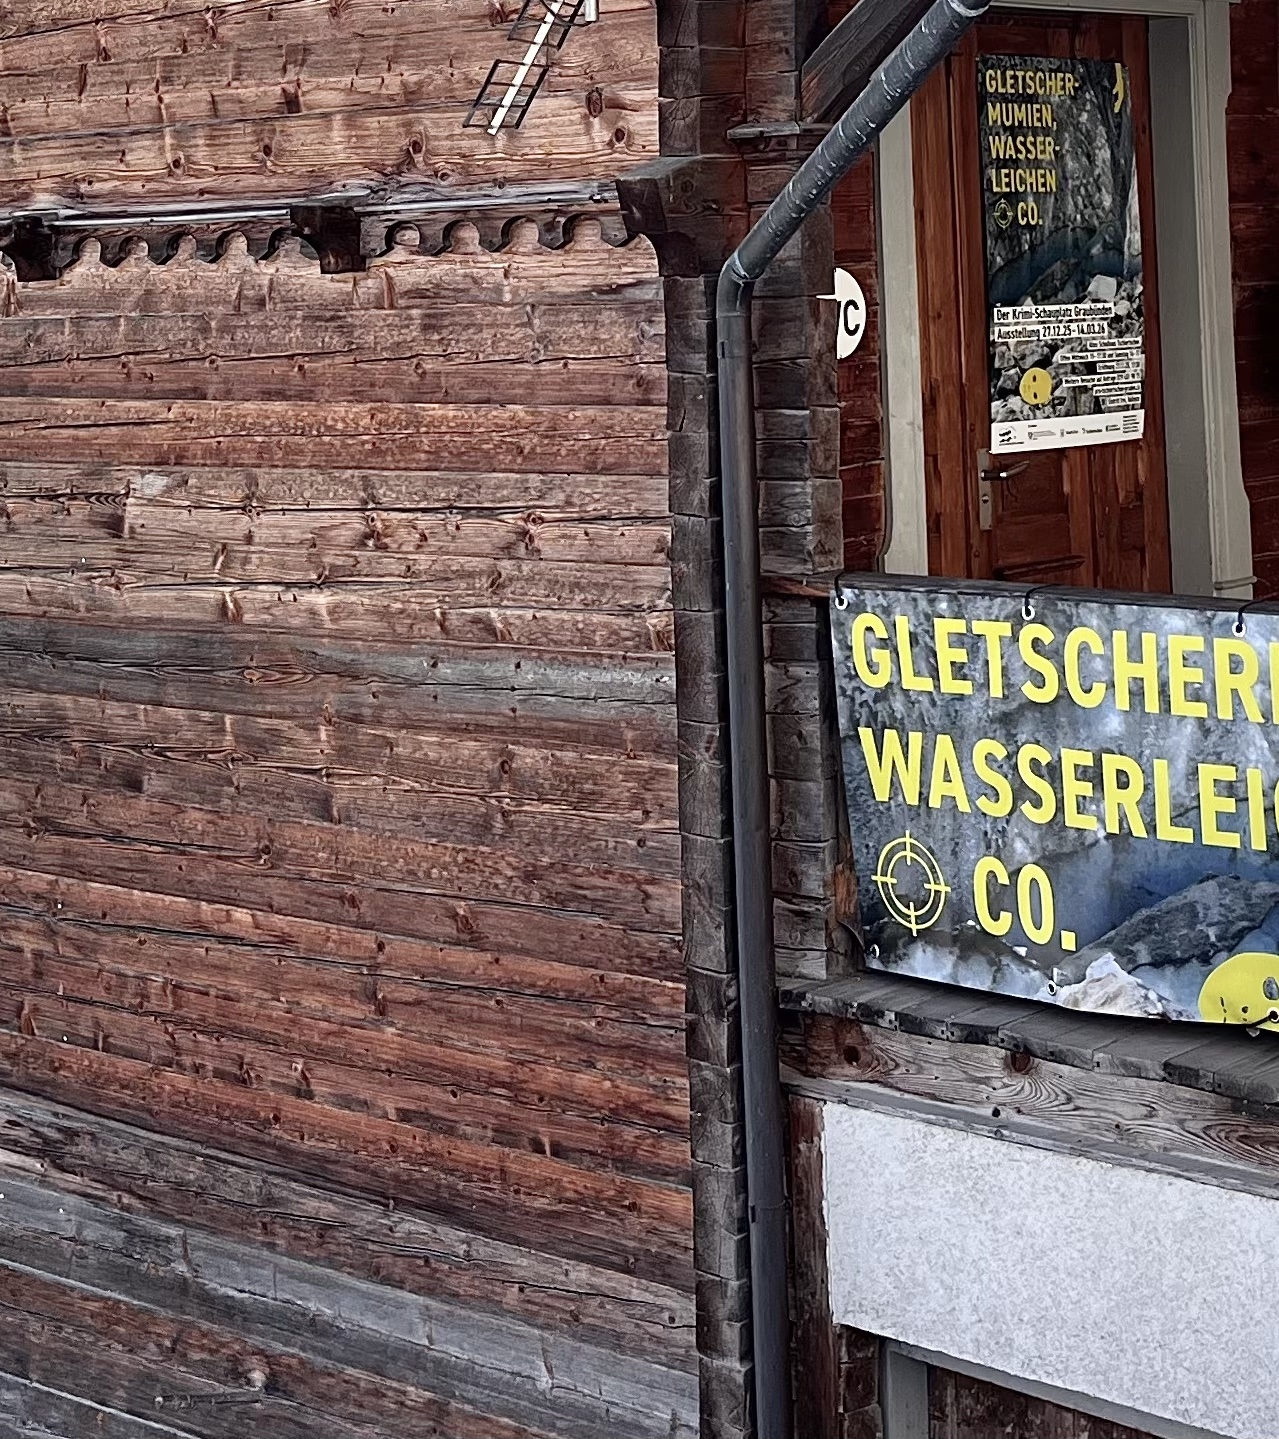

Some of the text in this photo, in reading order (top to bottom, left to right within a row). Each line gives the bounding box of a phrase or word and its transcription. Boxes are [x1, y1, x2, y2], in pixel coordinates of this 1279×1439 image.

[985, 69, 1080, 96] GLETSCHER-
[987, 102, 1057, 131] MUMIEN,
[988, 135, 1061, 160] WASSER-
[991, 168, 1057, 193] LEICHEN
[1017, 201, 1043, 226] CO.
[837, 299, 860, 336] C
[996, 303, 1113, 323] Der Krimi-Schauplatz Graubünden
[997, 326, 1041, 341] Ausstellung
[973, 856, 1077, 951] CO.
